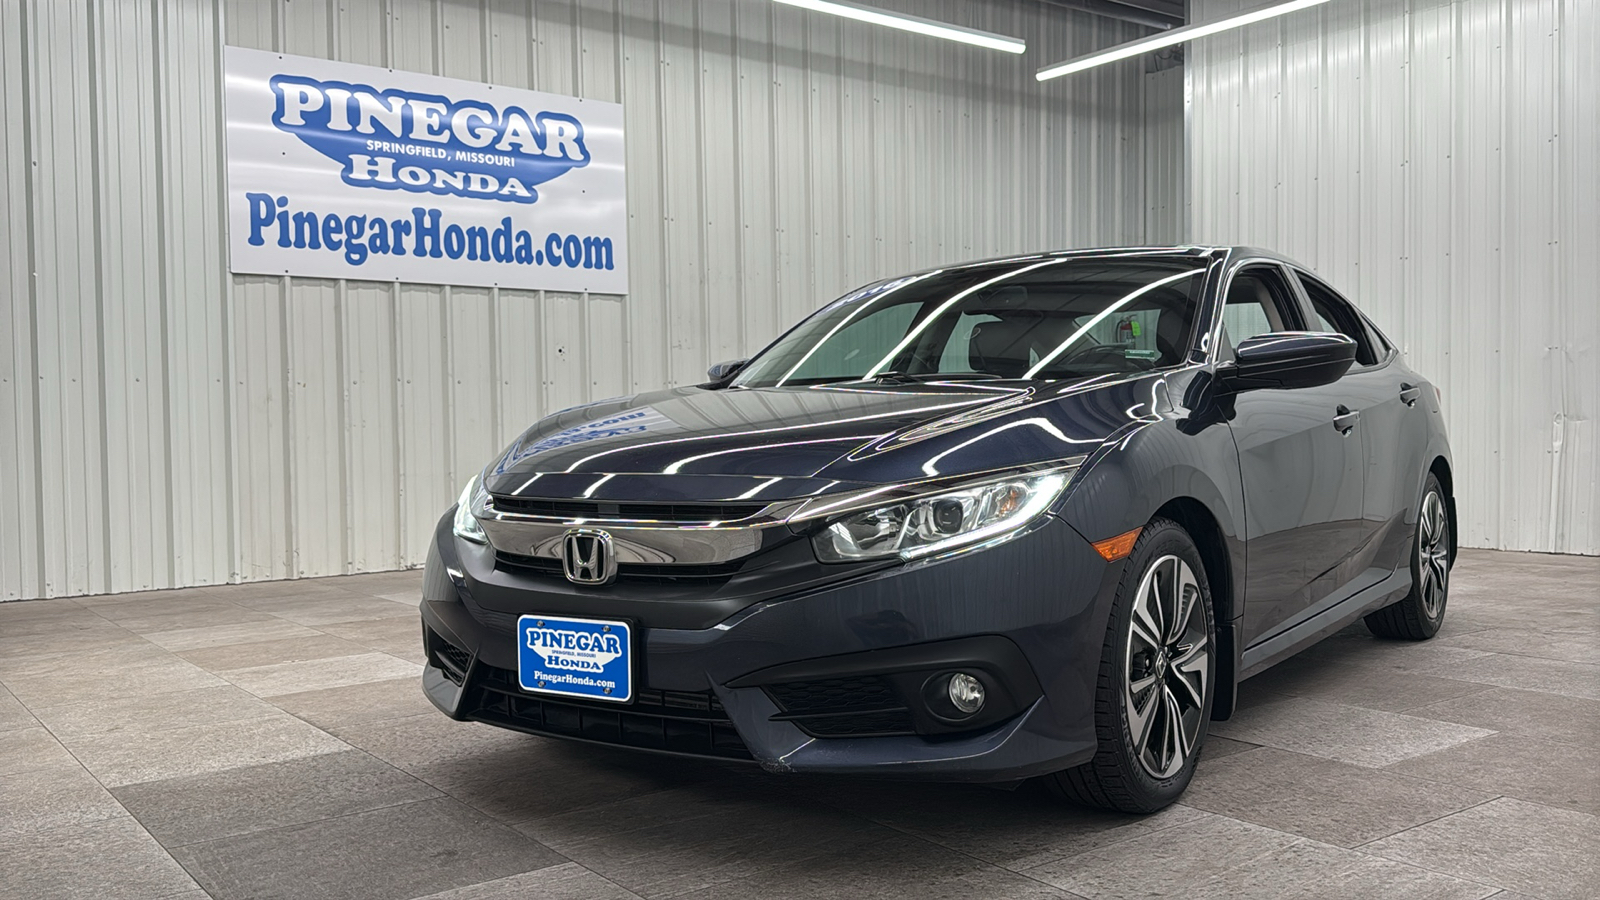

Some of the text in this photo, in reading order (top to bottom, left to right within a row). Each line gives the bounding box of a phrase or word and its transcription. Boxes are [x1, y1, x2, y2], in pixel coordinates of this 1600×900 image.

[276, 82, 586, 162] PINEGAR
[366, 140, 516, 168] SPRINGFIELD, MISSOURI
[348, 154, 536, 198] HONDA
[246, 192, 615, 270] PinegarHonda.com
[528, 630, 620, 655] PINEGAR
[547, 655, 601, 670] HONDA
[533, 670, 616, 689] PinegarHonda.com
